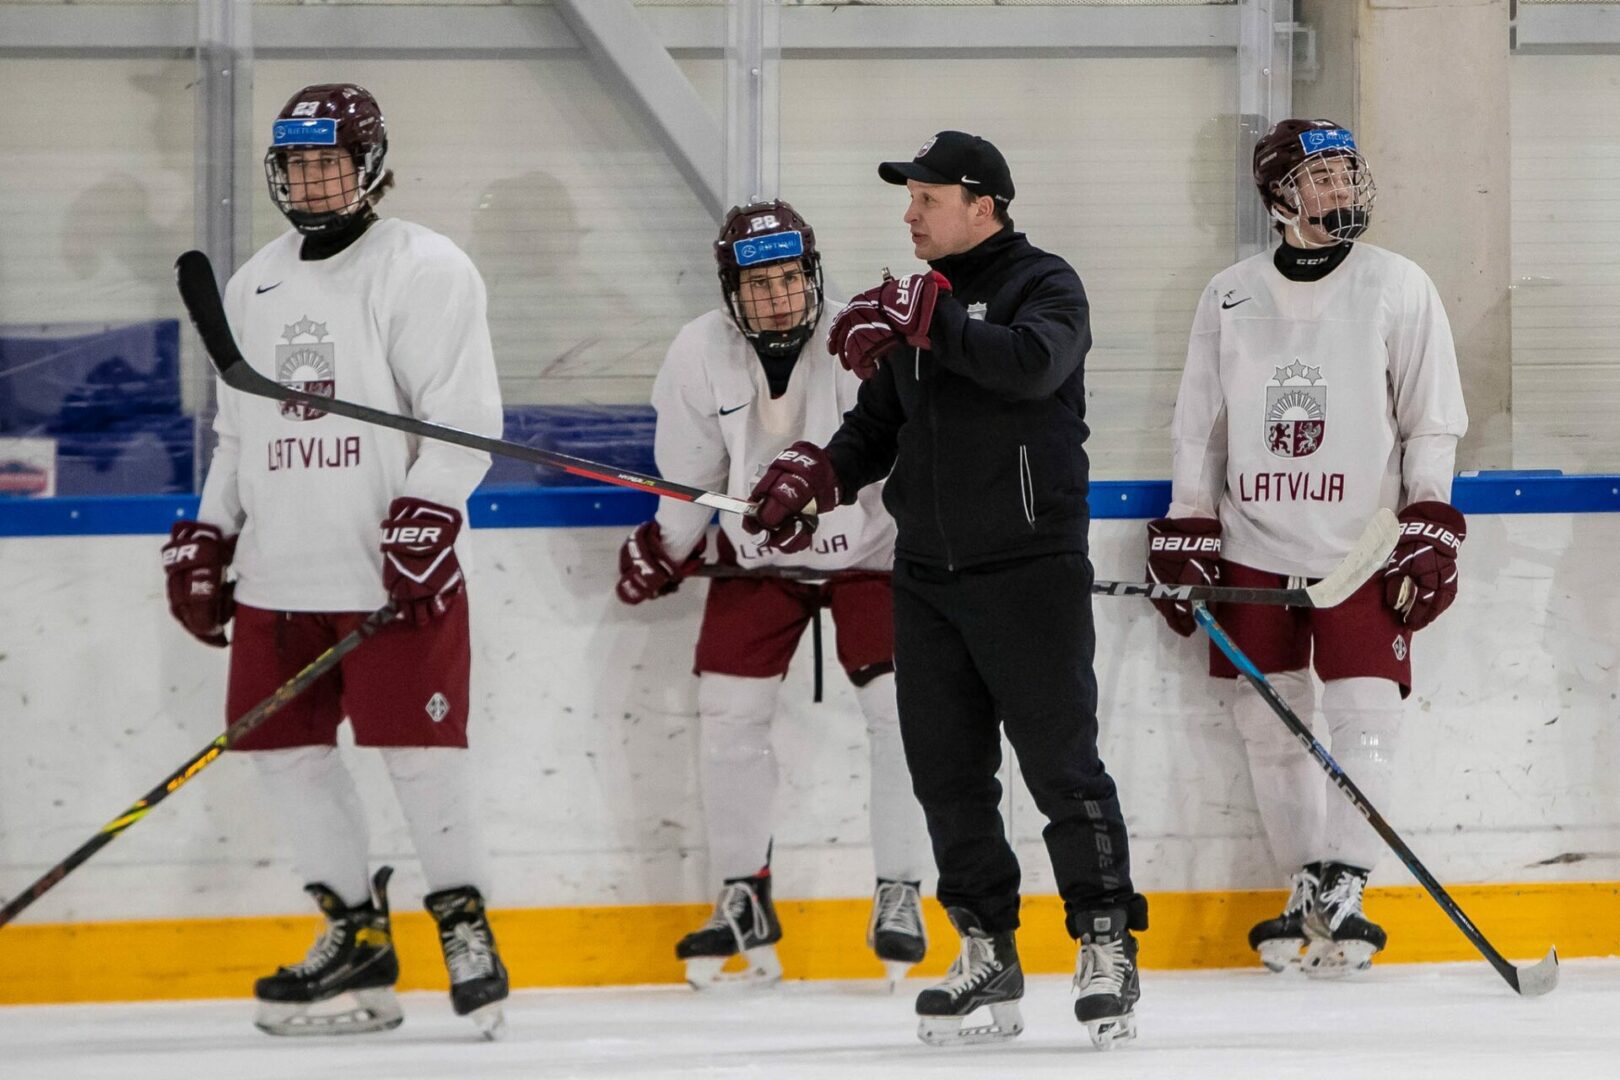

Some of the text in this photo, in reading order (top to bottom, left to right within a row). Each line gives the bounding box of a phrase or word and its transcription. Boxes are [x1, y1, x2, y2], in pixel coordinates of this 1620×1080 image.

[1296, 256, 1329, 265] CCM
[268, 436, 360, 471] LATVIJA
[1240, 472, 1345, 502] LATVIJA
[1152, 537, 1222, 552] BAUER
